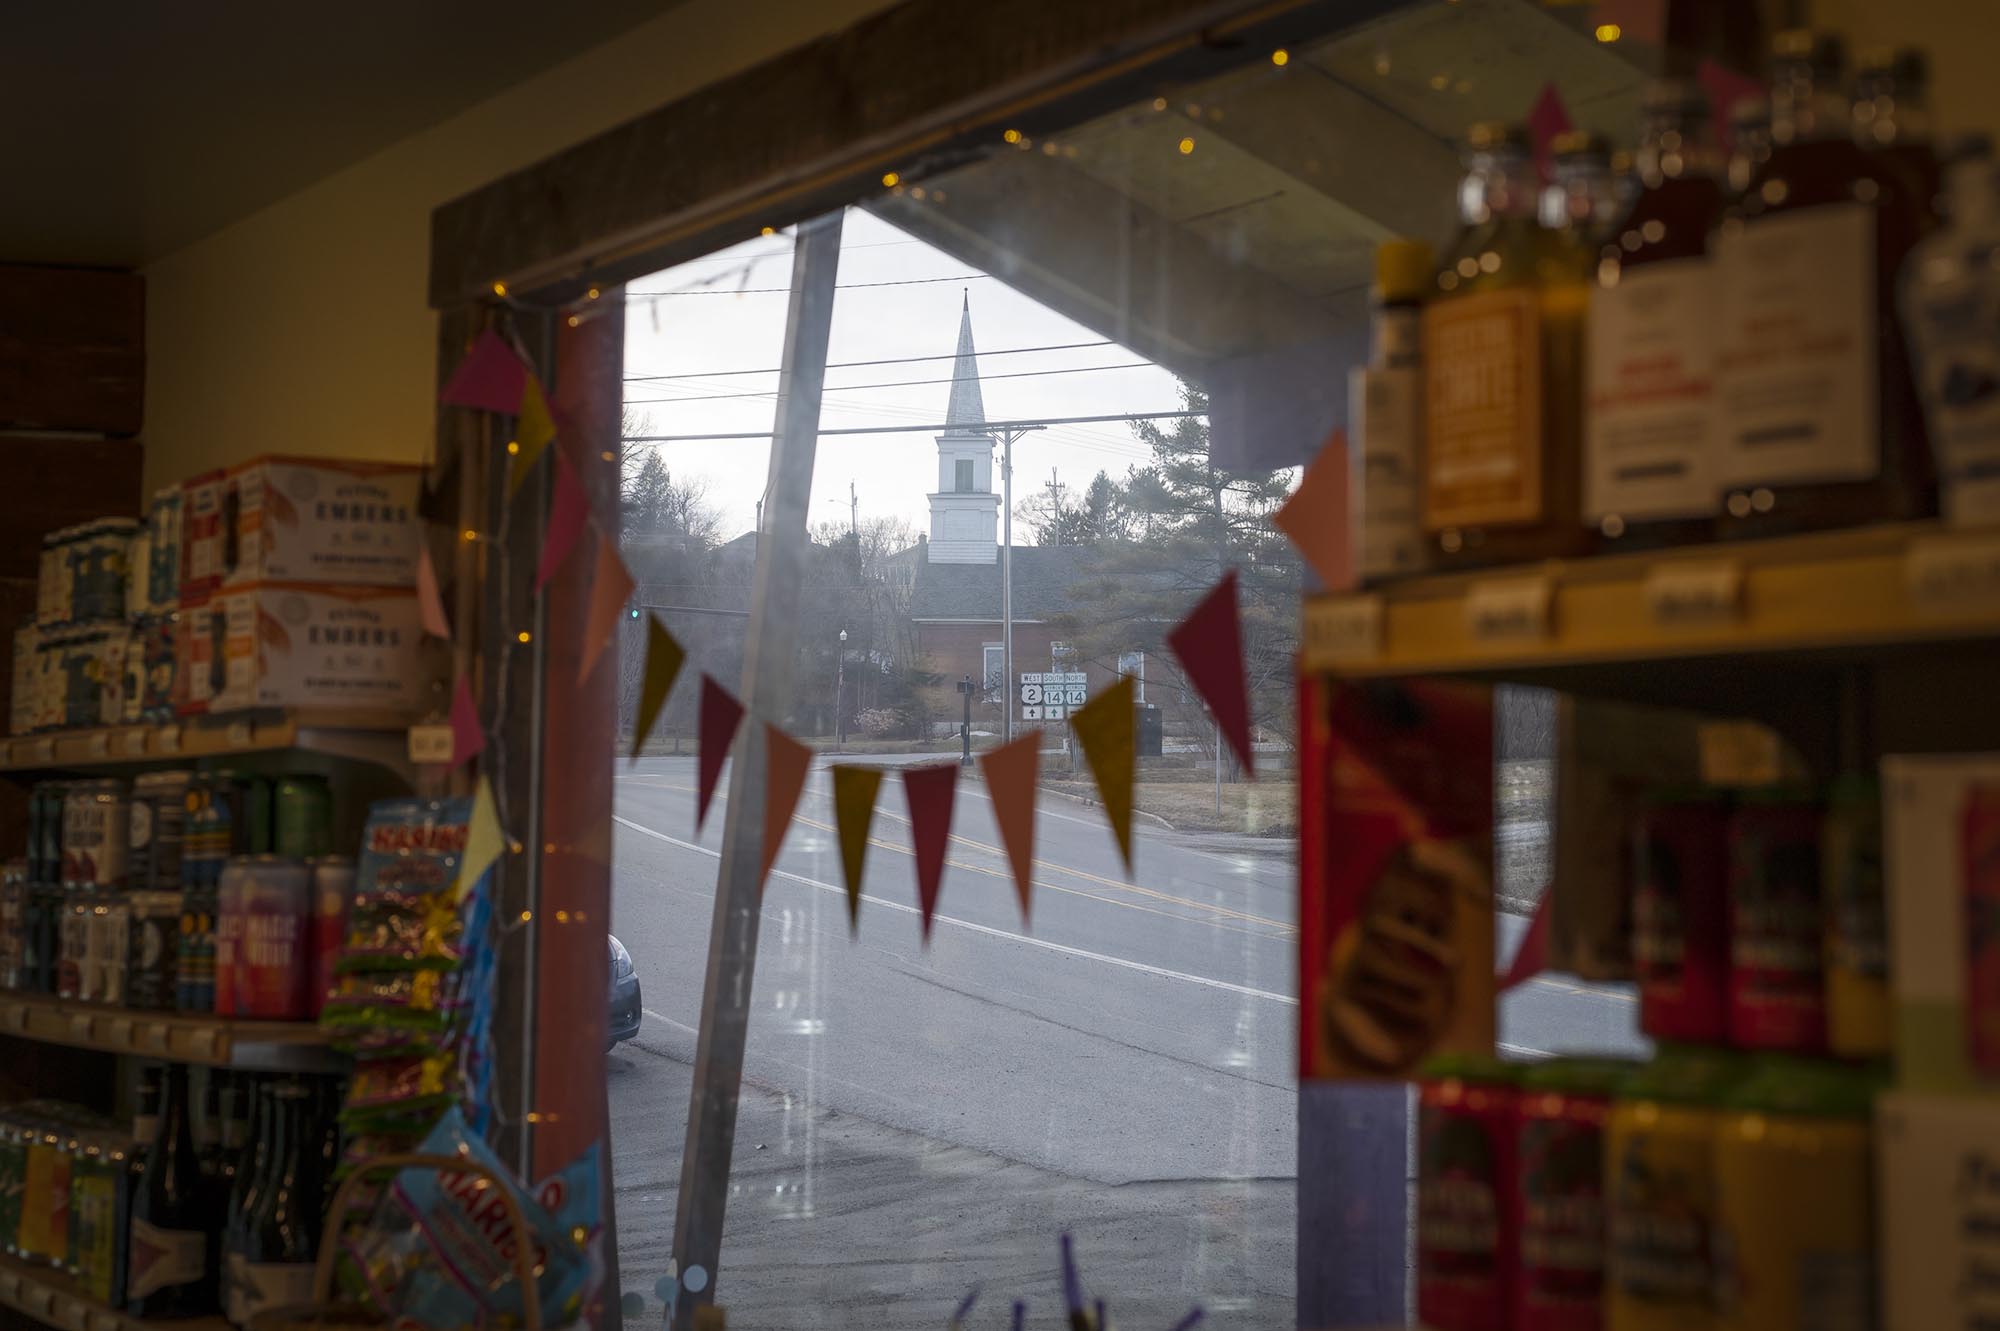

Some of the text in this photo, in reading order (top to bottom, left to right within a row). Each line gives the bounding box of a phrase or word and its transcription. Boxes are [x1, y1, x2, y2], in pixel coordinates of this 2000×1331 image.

[1024, 674, 1041, 682] WEST
[1044, 674, 1063, 682] SOUTH
[1065, 674, 1086, 682] NORTH
[1028, 689, 1036, 701] 2
[1047, 692, 1061, 704] 14
[1070, 692, 1083, 704] 14
